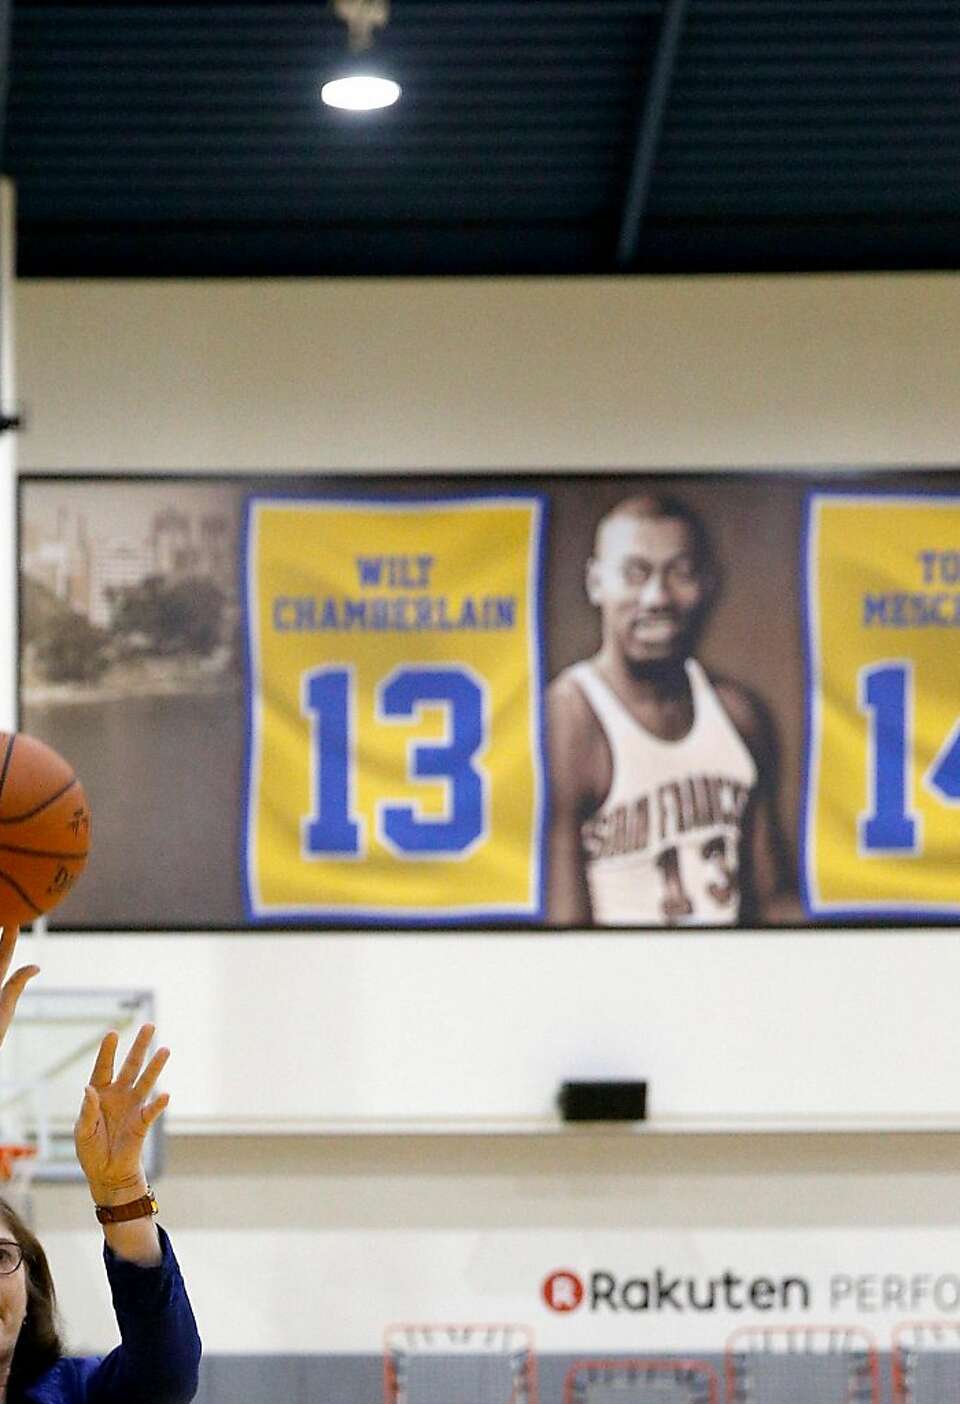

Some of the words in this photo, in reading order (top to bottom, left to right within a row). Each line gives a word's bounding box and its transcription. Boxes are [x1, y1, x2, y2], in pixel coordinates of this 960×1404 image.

[356, 555, 435, 589] WILT
[273, 596, 516, 632] CHAMBERLAIN
[300, 662, 490, 860] 13
[590, 1267, 812, 1313] Rakuten
